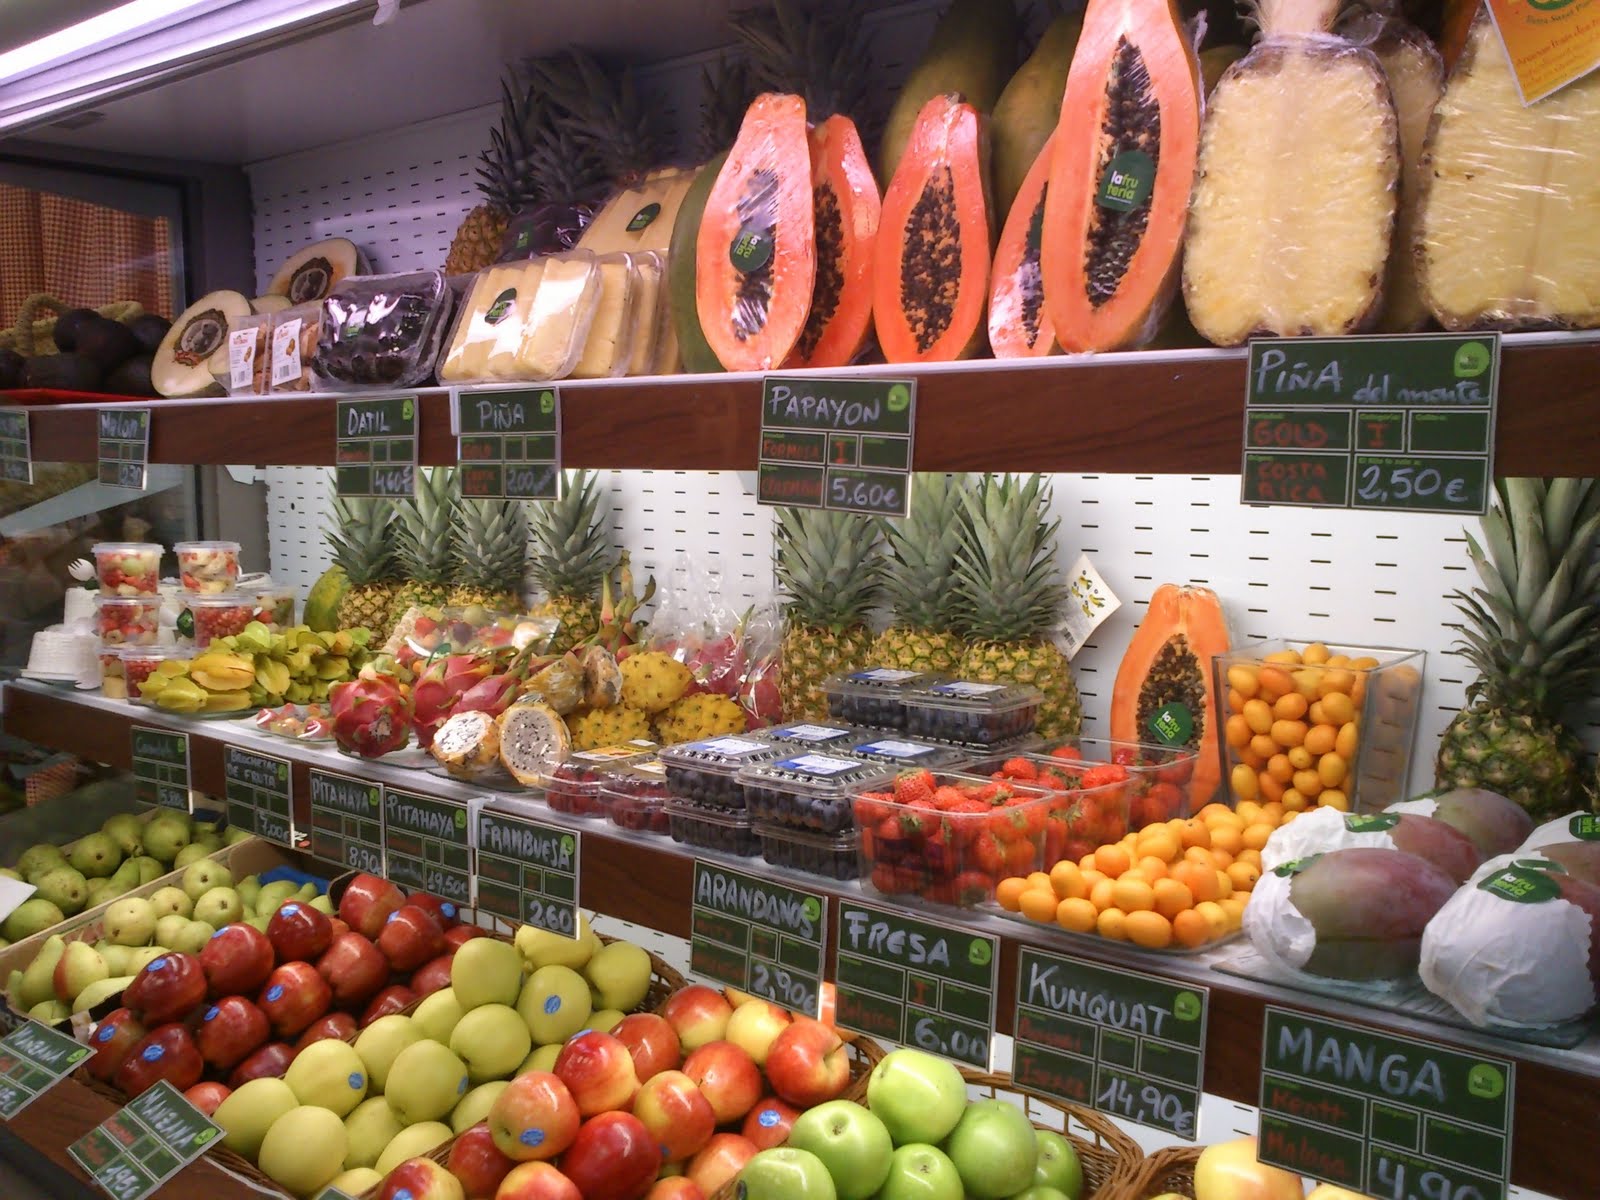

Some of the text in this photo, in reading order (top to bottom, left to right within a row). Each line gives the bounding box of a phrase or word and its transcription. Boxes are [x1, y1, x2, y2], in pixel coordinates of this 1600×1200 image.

[1255, 349, 1343, 393] PIÑA
[1353, 374, 1390, 402] del
[347, 408, 391, 436] DATIL
[476, 400, 525, 430] PIÑA
[769, 385, 880, 427] PAPAYON
[1254, 420, 1329, 448] GOLD
[480, 818, 570, 871] FRAMBUESA
[844, 911, 950, 968] FRESA
[1279, 1025, 1447, 1102] MANGA
